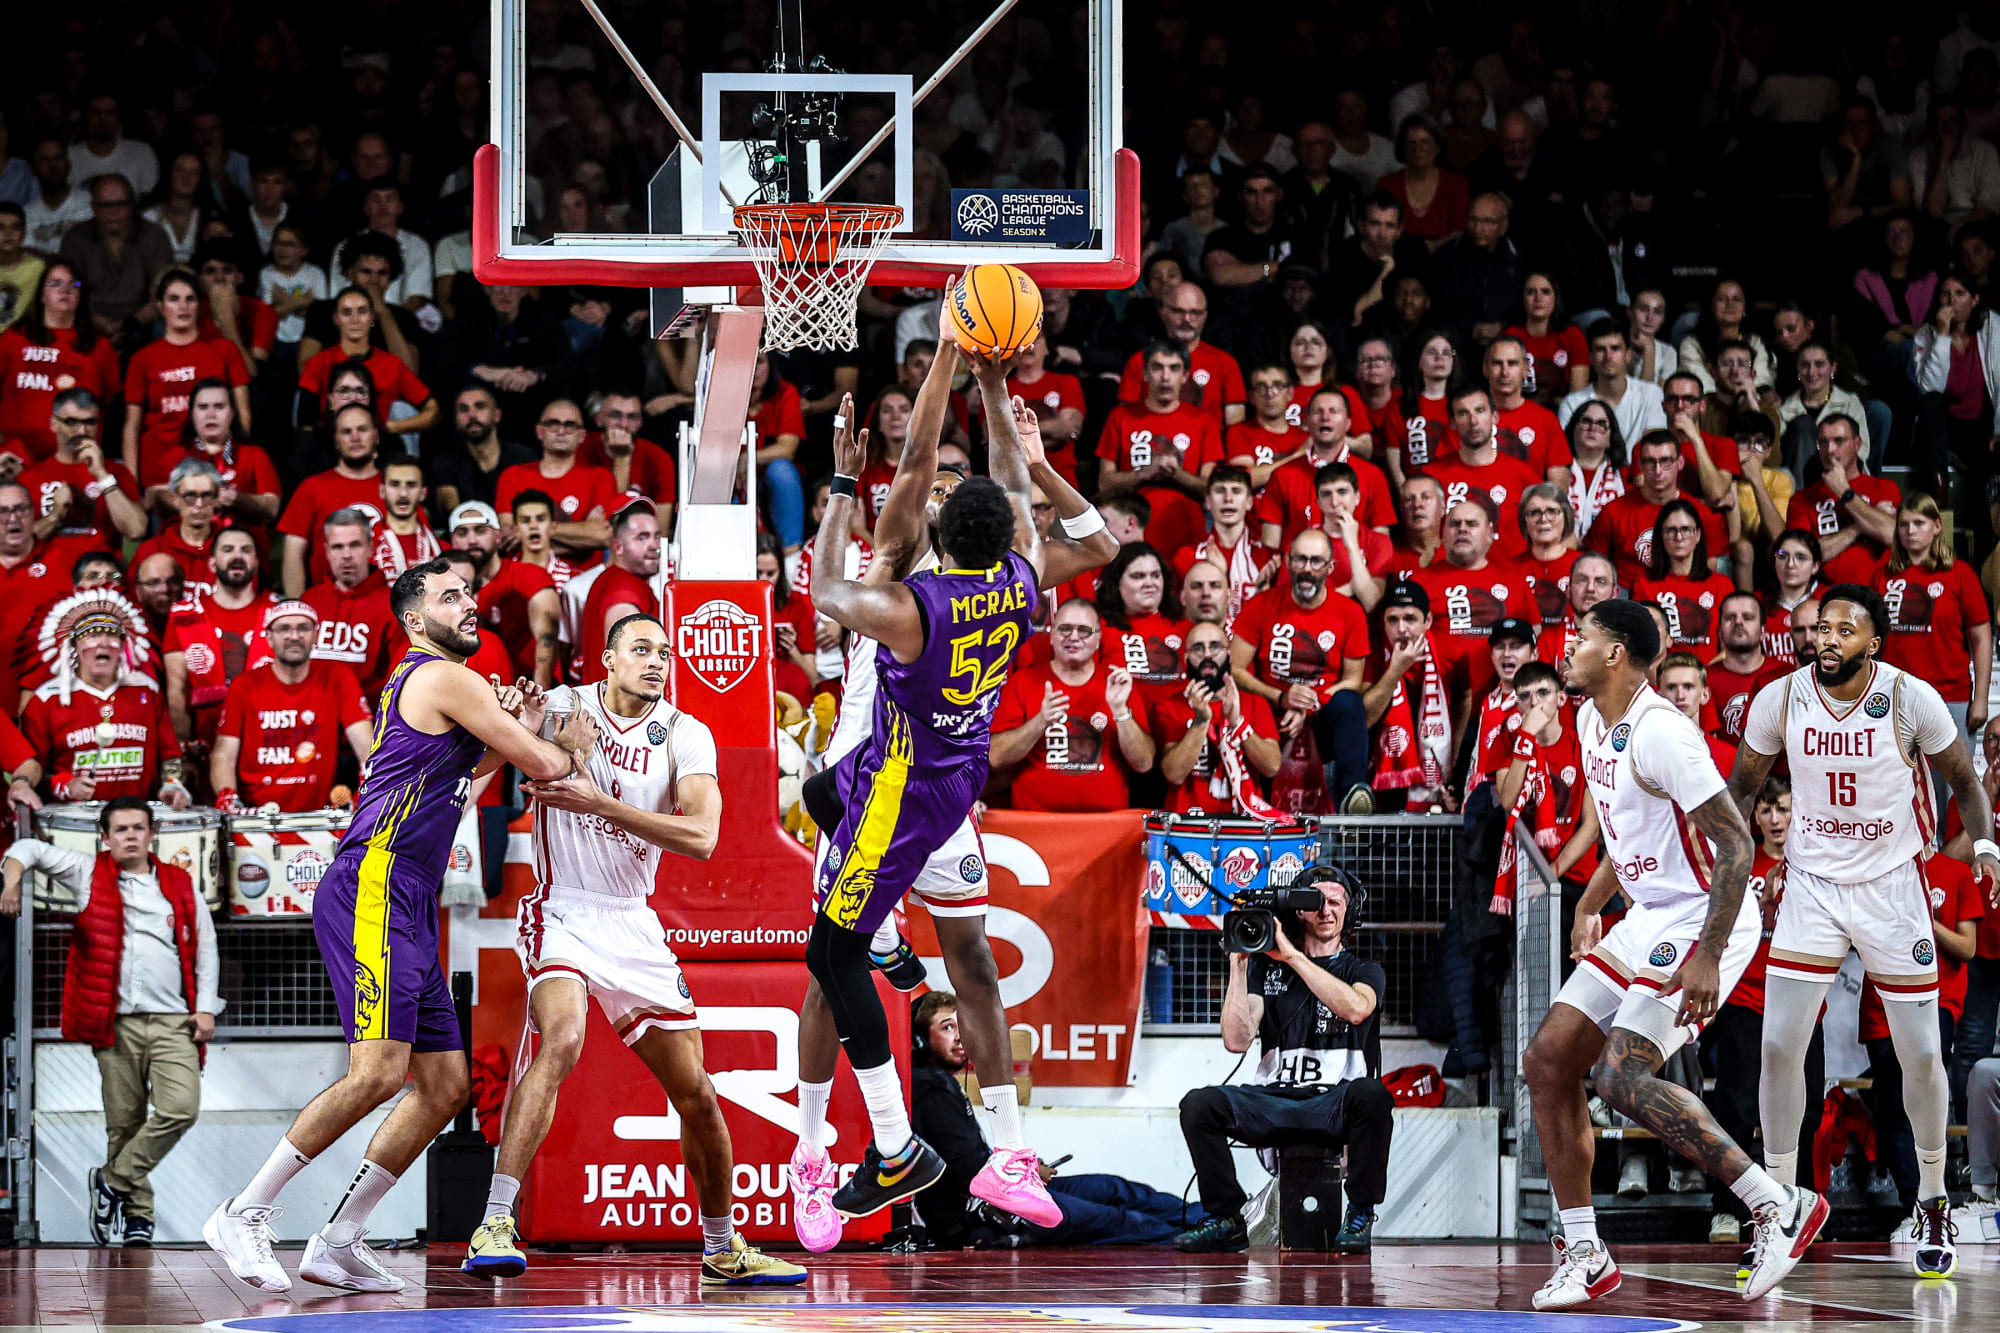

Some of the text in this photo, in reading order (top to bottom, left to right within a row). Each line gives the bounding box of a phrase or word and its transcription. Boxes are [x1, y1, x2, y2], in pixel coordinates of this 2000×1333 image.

[1001, 194, 1075, 204] BASKETBALL
[1001, 204, 1084, 216] CHAMPIONS
[1001, 215, 1047, 226] LEAGUE
[1002, 227, 1047, 236] SEASON X
[22, 346, 60, 363] JUST
[1130, 430, 1152, 471] EDS
[1407, 415, 1429, 465] REDS
[1815, 498, 1839, 536] EDS
[950, 581, 1027, 624] MCRAE
[1445, 584, 1472, 629] REDS
[312, 620, 370, 653] EDS
[677, 624, 763, 658] CHOLET
[1269, 622, 1296, 677] REDS
[698, 658, 745, 672] BASKET
[941, 621, 1020, 706] 52
[1121, 633, 1151, 674] REDS
[258, 709, 298, 730] JUST
[256, 746, 296, 765] FAN.
[1803, 727, 1876, 758] CHOLET
[1585, 749, 1618, 791] CHOLET
[1825, 771, 1858, 808] 15
[1816, 817, 1894, 842] solengie
[286, 863, 330, 882] CHOLE
[583, 1163, 687, 1203] JEAN
